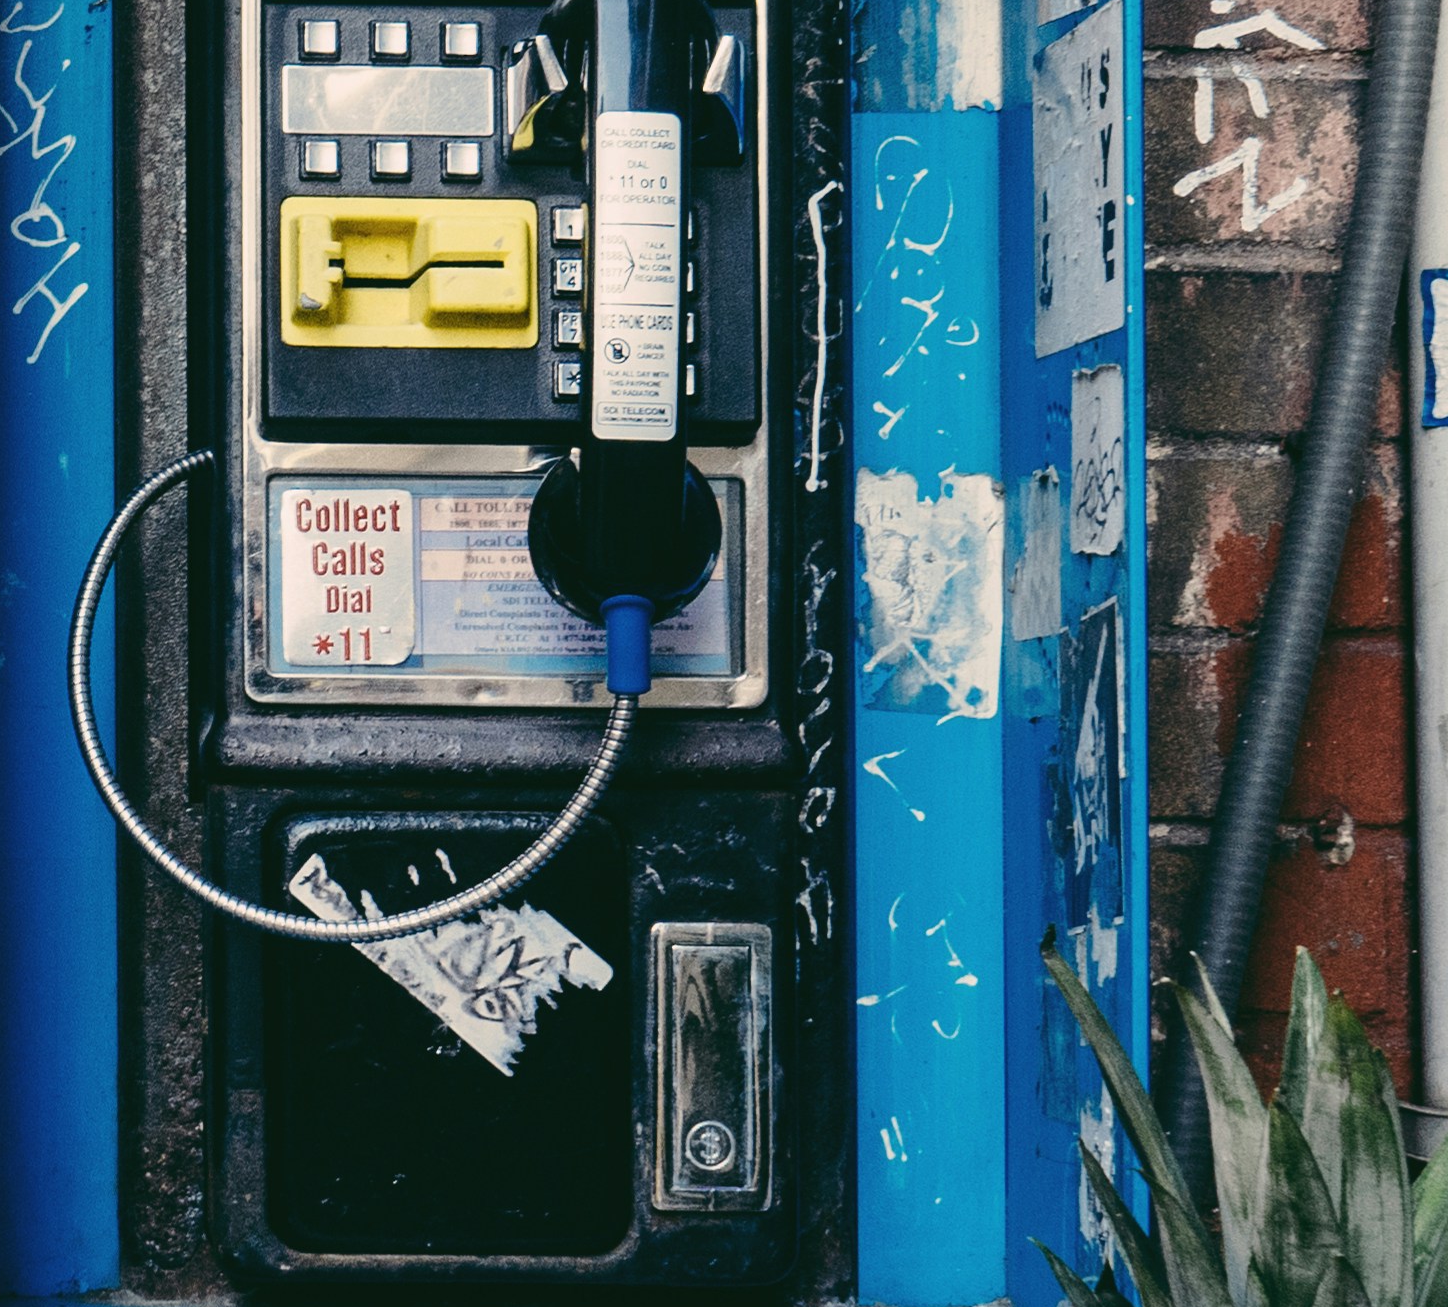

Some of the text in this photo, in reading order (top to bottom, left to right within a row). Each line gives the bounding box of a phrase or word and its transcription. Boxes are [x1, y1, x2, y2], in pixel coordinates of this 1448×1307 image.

[630, 128, 671, 138] COLLECT
[651, 141, 677, 151] CARD
[627, 160, 650, 170] DIAL
[640, 179, 656, 189] or
[660, 176, 669, 190] 0
[623, 195, 677, 206] OPERATOR
[567, 224, 574, 237] 1
[559, 261, 578, 274] GH
[566, 276, 576, 288] 4
[562, 314, 578, 326] PR
[569, 328, 578, 341] 7
[622, 406, 667, 416] TELECOM
[515, 502, 532, 513] FR
[295, 497, 401, 533] Collect
[465, 535, 501, 548] Local
[312, 541, 386, 576] Calls
[465, 554, 495, 565] DIAL
[487, 583, 546, 593] EMERGEN
[326, 584, 372, 614] Dial
[489, 609, 541, 620] Complaints
[507, 622, 559, 632] Complaints
